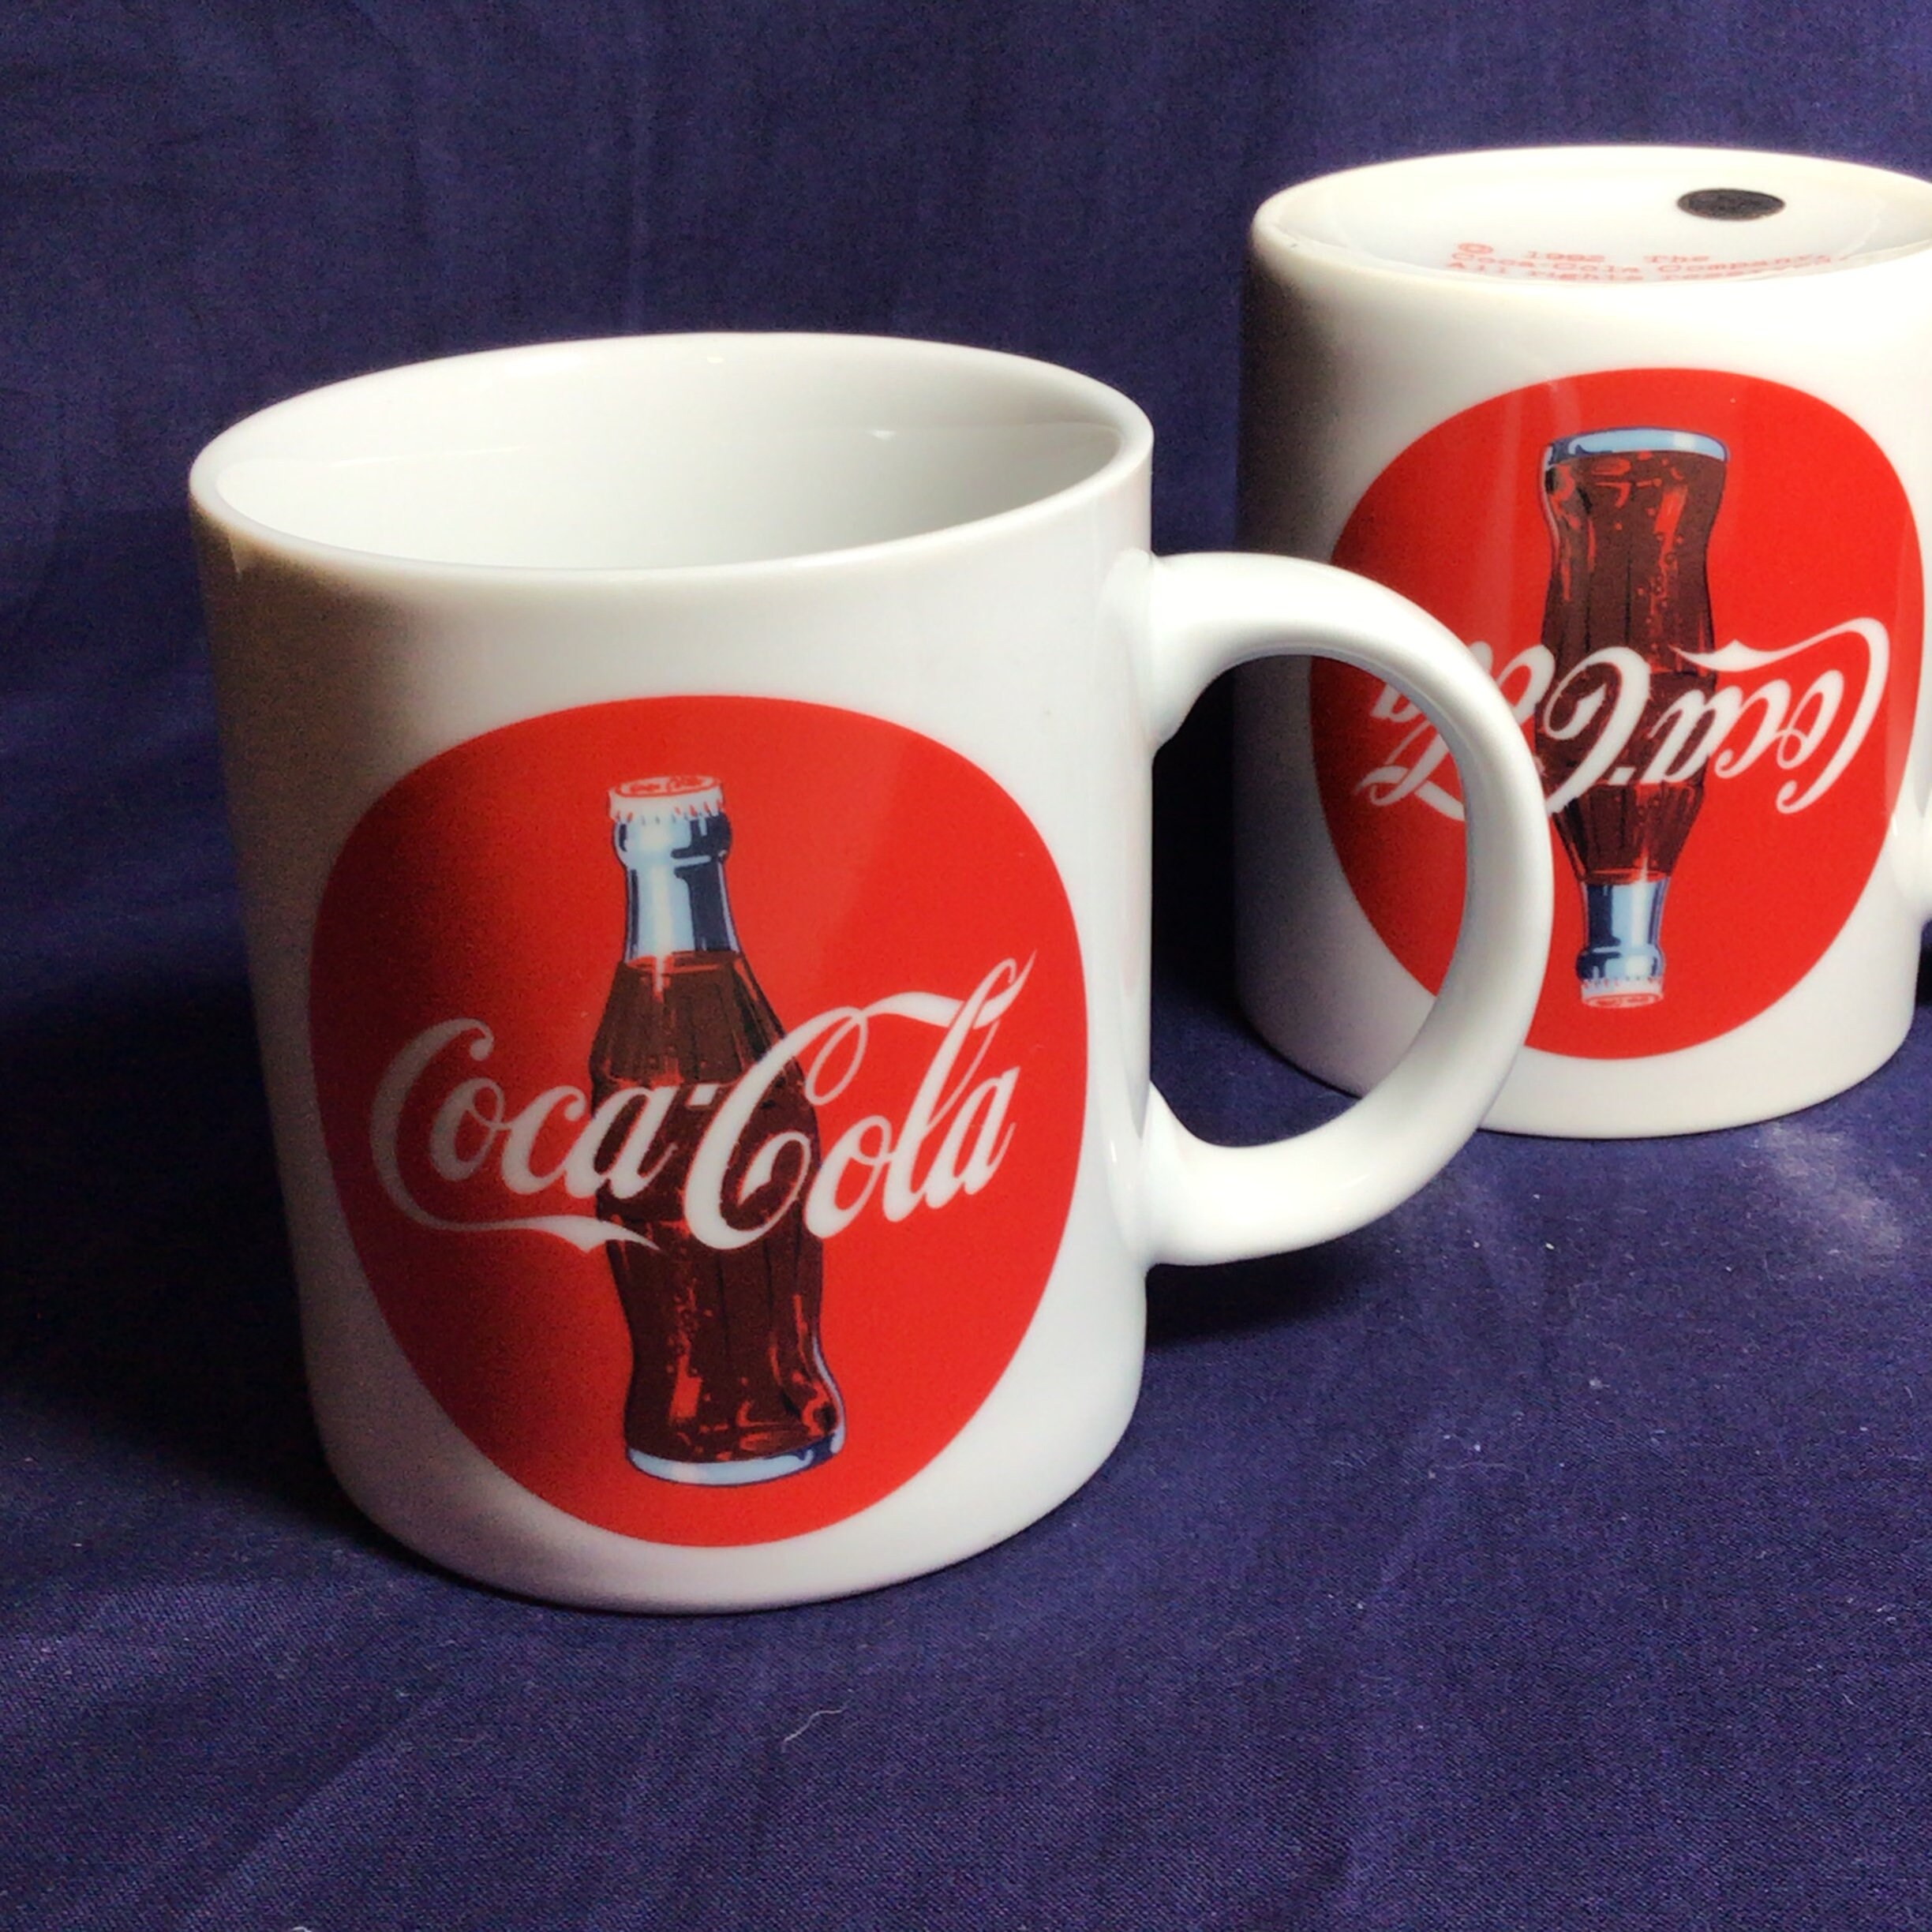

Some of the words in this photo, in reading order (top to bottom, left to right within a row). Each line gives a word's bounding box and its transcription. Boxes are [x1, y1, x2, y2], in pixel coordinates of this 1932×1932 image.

[1451, 253, 1639, 272] Coca-Cola
[1643, 255, 1710, 264] The
[1447, 263, 1506, 275] All
[370, 949, 1037, 1250] Coca-Cola
